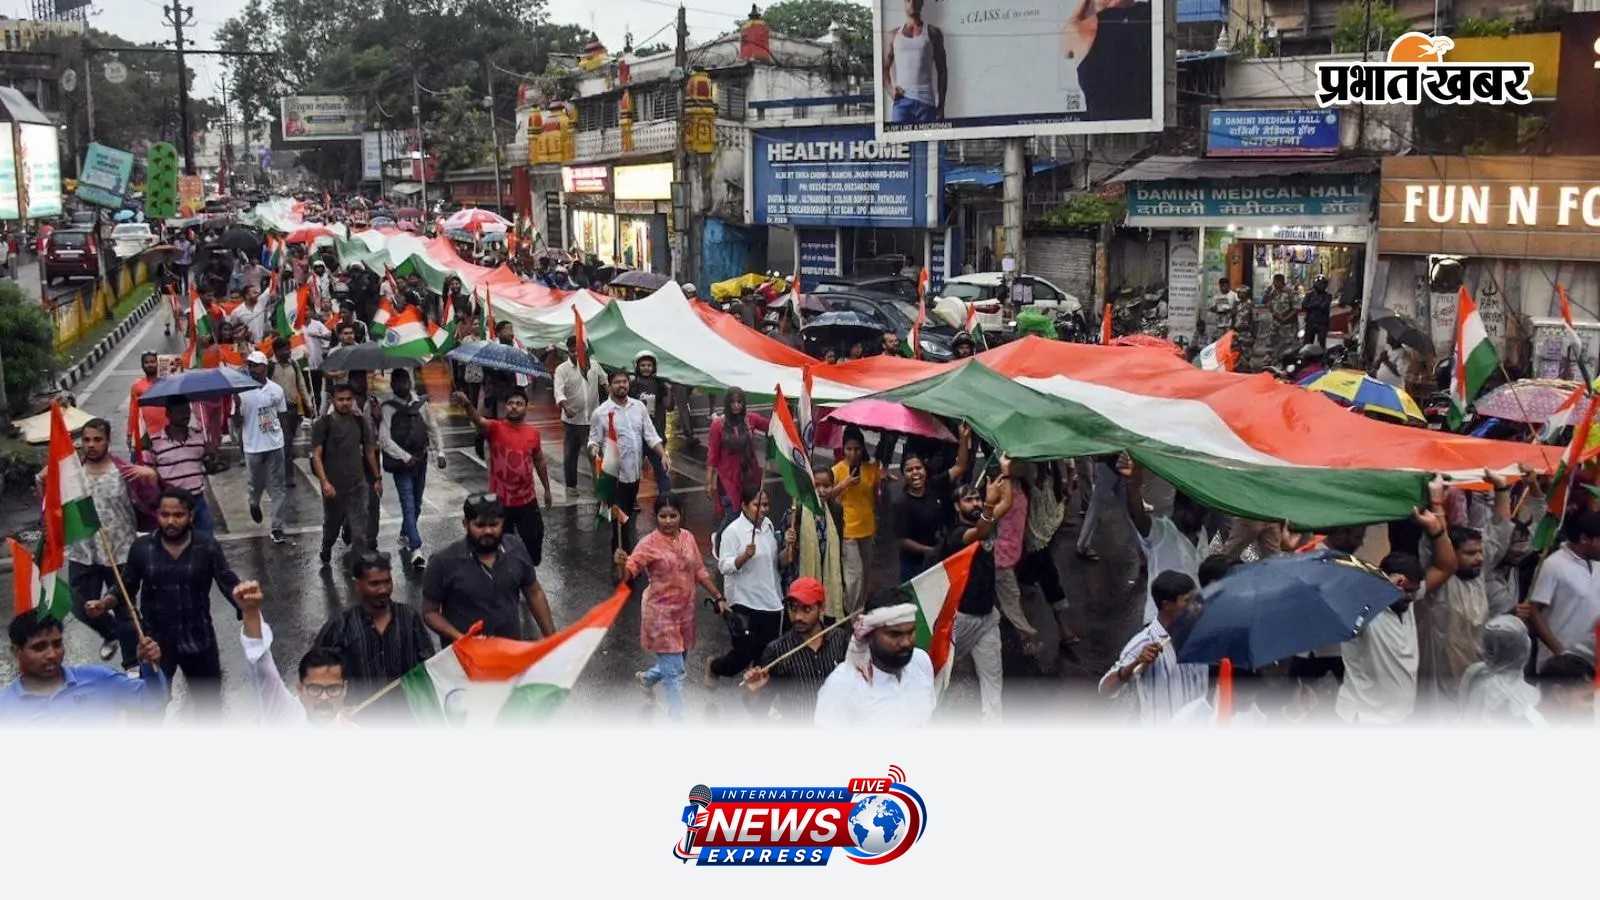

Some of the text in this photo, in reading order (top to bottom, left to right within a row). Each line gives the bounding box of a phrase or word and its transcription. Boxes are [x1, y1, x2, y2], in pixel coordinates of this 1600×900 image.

[966, 9, 1000, 24] CLASS
[1225, 115, 1321, 125] DAMINI MEDICAL HALL
[767, 140, 910, 162] HEALTH HOME
[1136, 185, 1368, 201] DAMINI MEDICAL HALL
[1136, 202, 1205, 215] दामिनी
[1403, 185, 1489, 224] FUN
[1507, 186, 1539, 225] N
[1273, 230, 1324, 240] MEDICAL HALL
